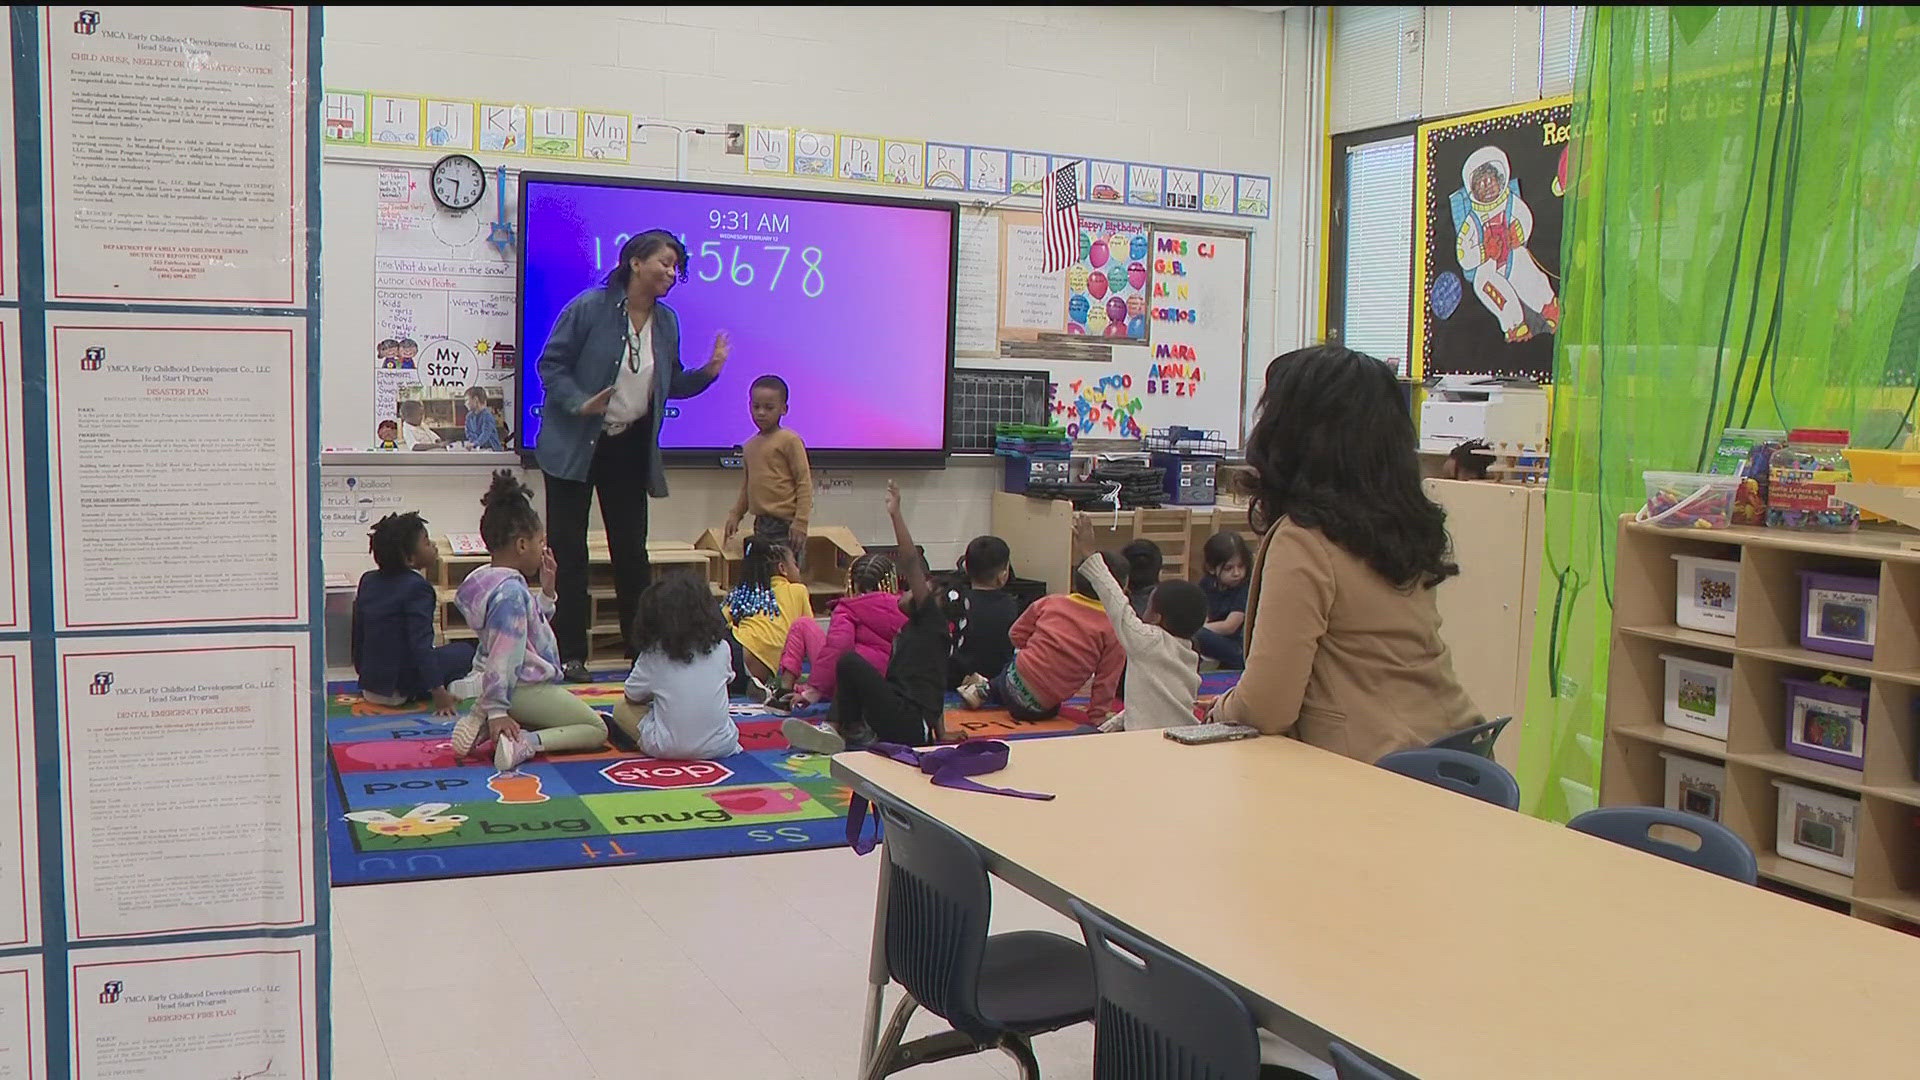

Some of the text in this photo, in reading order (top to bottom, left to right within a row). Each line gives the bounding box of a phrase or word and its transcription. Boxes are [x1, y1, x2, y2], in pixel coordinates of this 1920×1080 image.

[101, 30, 125, 39] YMCA
[128, 33, 147, 42] Early
[150, 34, 188, 43] Childhood
[255, 43, 271, 51] LLC
[138, 42, 156, 51] Head
[159, 44, 178, 53] Start
[71, 53, 97, 61] CHILD
[132, 58, 171, 67] NEGLECT
[708, 209, 790, 234] 9:31 AM
[1079, 218, 1144, 234] Happy Birthday!
[719, 233, 749, 241] WEDNESDAY
[749, 234, 773, 242] FEBRUARY
[1157, 237, 1188, 256] MRS
[1197, 242, 1215, 259] CJ
[699, 241, 723, 282] 5
[730, 245, 755, 287] 6
[763, 246, 791, 292] 7
[801, 246, 825, 299] 8
[1154, 258, 1187, 277] GAEL
[377, 290, 423, 300] Characters
[436, 347, 460, 364] My
[106, 365, 130, 373] YMCA
[132, 365, 151, 374] Early
[153, 365, 189, 373] Childhood
[191, 365, 238, 374] Development
[256, 365, 271, 373] LLC
[427, 363, 469, 379] Story
[182, 375, 213, 383] Program
[146, 388, 209, 396] DISASTER PLAN
[361, 480, 391, 488] balloon
[328, 495, 351, 506] truck
[331, 529, 346, 538] car
[115, 687, 137, 695] YMCA
[139, 687, 158, 695] Early
[160, 685, 196, 693] Childhood
[197, 683, 243, 692] Development
[148, 695, 167, 703] Head
[189, 693, 219, 702] Program
[117, 705, 251, 719] DENTAL EMERGENCY PROCEDURES
[613, 763, 716, 781] stop
[363, 778, 470, 795] pop
[614, 808, 734, 827] mug
[479, 818, 592, 836] bug
[124, 995, 146, 1003] YMCA
[148, 994, 166, 1002] Early
[168, 991, 204, 1000] Childhood
[205, 986, 250, 995] Development
[267, 984, 281, 992] LLC
[157, 998, 227, 1010] Head Start Program
[147, 1008, 237, 1023] EMERGENCY FIRE PLAN
